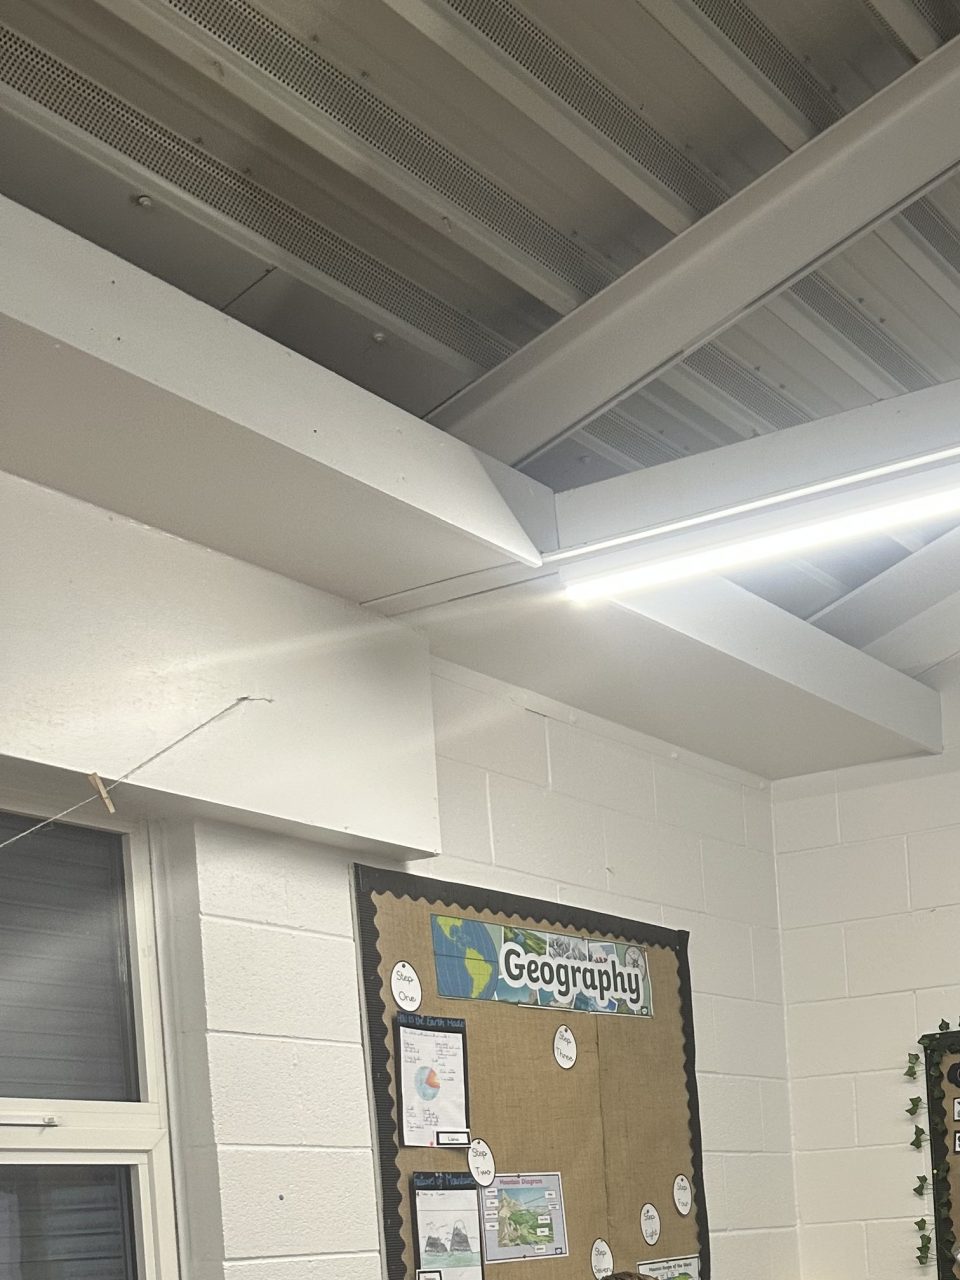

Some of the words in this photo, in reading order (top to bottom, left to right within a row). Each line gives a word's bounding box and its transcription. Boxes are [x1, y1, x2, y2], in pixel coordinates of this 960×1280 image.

[396, 971, 414, 985] Step
[504, 948, 641, 1004] Geography
[398, 991, 416, 1003] One
[559, 1031, 572, 1046] Step
[556, 1047, 574, 1063] Three
[472, 1148, 487, 1159] Step
[475, 1167, 491, 1176] Two
[521, 1178, 543, 1187] Diagram
[677, 1182, 688, 1192] Step
[644, 1213, 655, 1222] Step
[645, 1229, 658, 1240] Eight
[595, 1247, 607, 1257] Step
[594, 1265, 612, 1274] Seven
